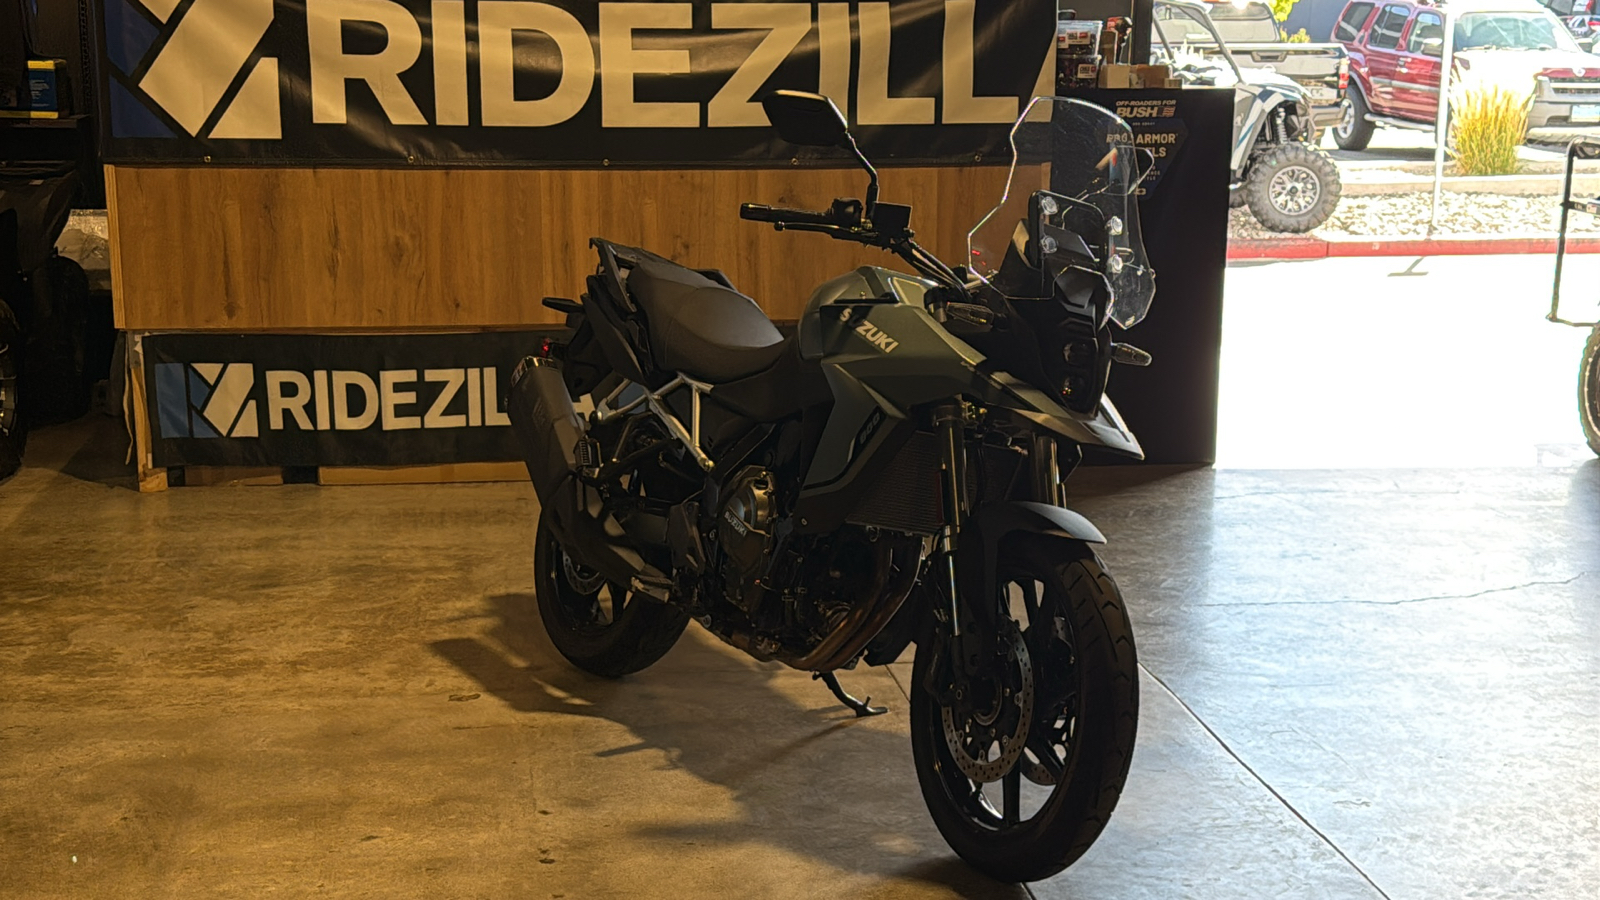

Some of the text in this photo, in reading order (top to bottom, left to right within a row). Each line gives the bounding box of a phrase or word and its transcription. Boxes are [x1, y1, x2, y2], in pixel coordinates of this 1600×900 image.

[306, 0, 1056, 127] RIDEZILL
[1116, 107, 1158, 117] BUSH
[1136, 133, 1176, 144] ARMOR
[724, 510, 748, 538] SUZUKI
